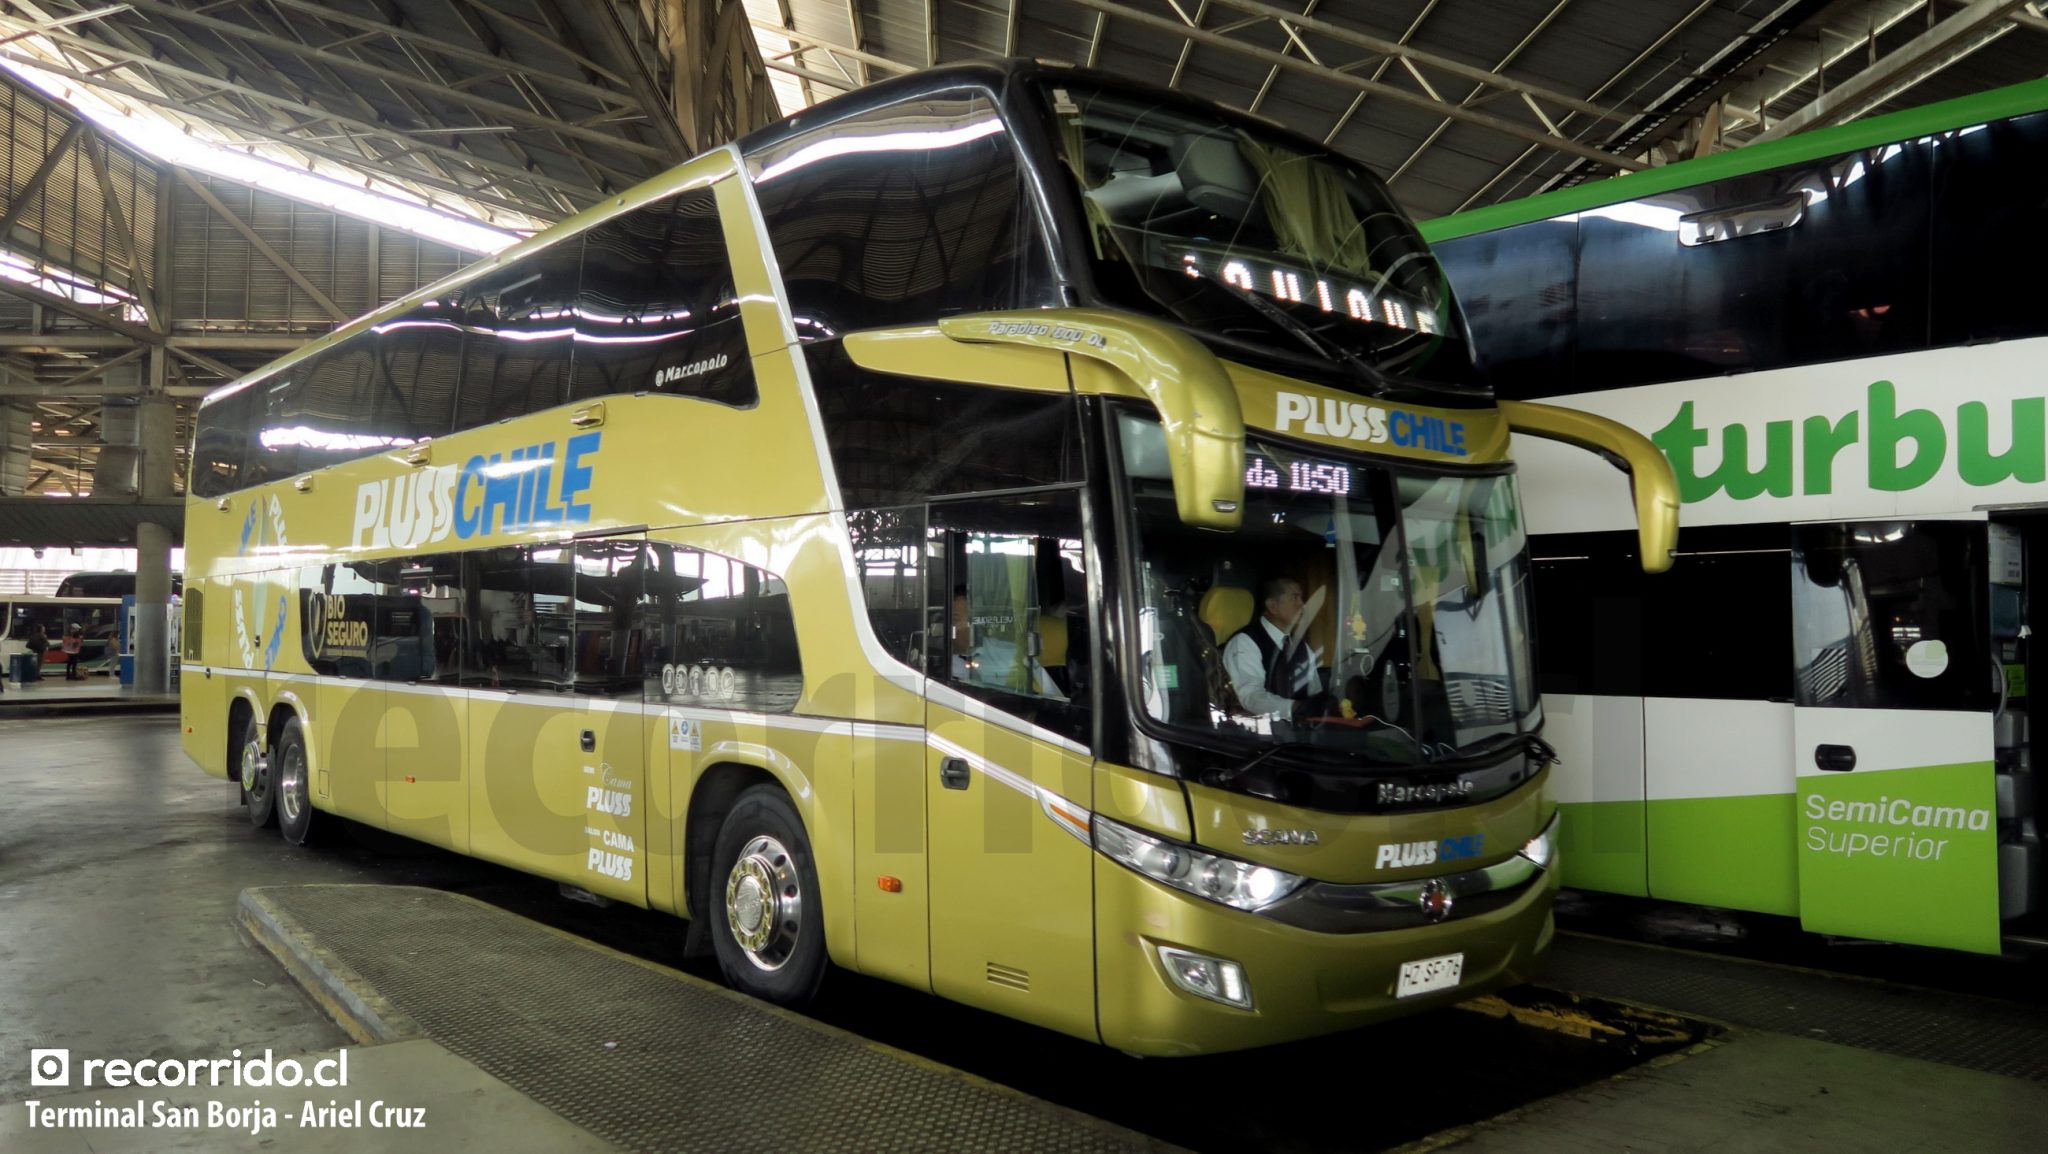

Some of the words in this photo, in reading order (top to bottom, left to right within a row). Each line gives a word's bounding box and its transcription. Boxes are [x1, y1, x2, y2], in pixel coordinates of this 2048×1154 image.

[988, 321, 1048, 336] Paradiso
[665, 353, 728, 383] Marcopolo
[1290, 462, 1350, 495] 11:50
[327, 595, 346, 619] BIO
[327, 621, 369, 647] SEGURO
[586, 786, 632, 817] PLUSS
[1378, 778, 1474, 804] Marcopolo
[1805, 794, 1990, 831] SemiCama
[603, 830, 634, 852] CAMA
[1242, 829, 1319, 846] SCANIA
[1807, 826, 1949, 861] Superior
[587, 847, 632, 881] PLUSS
